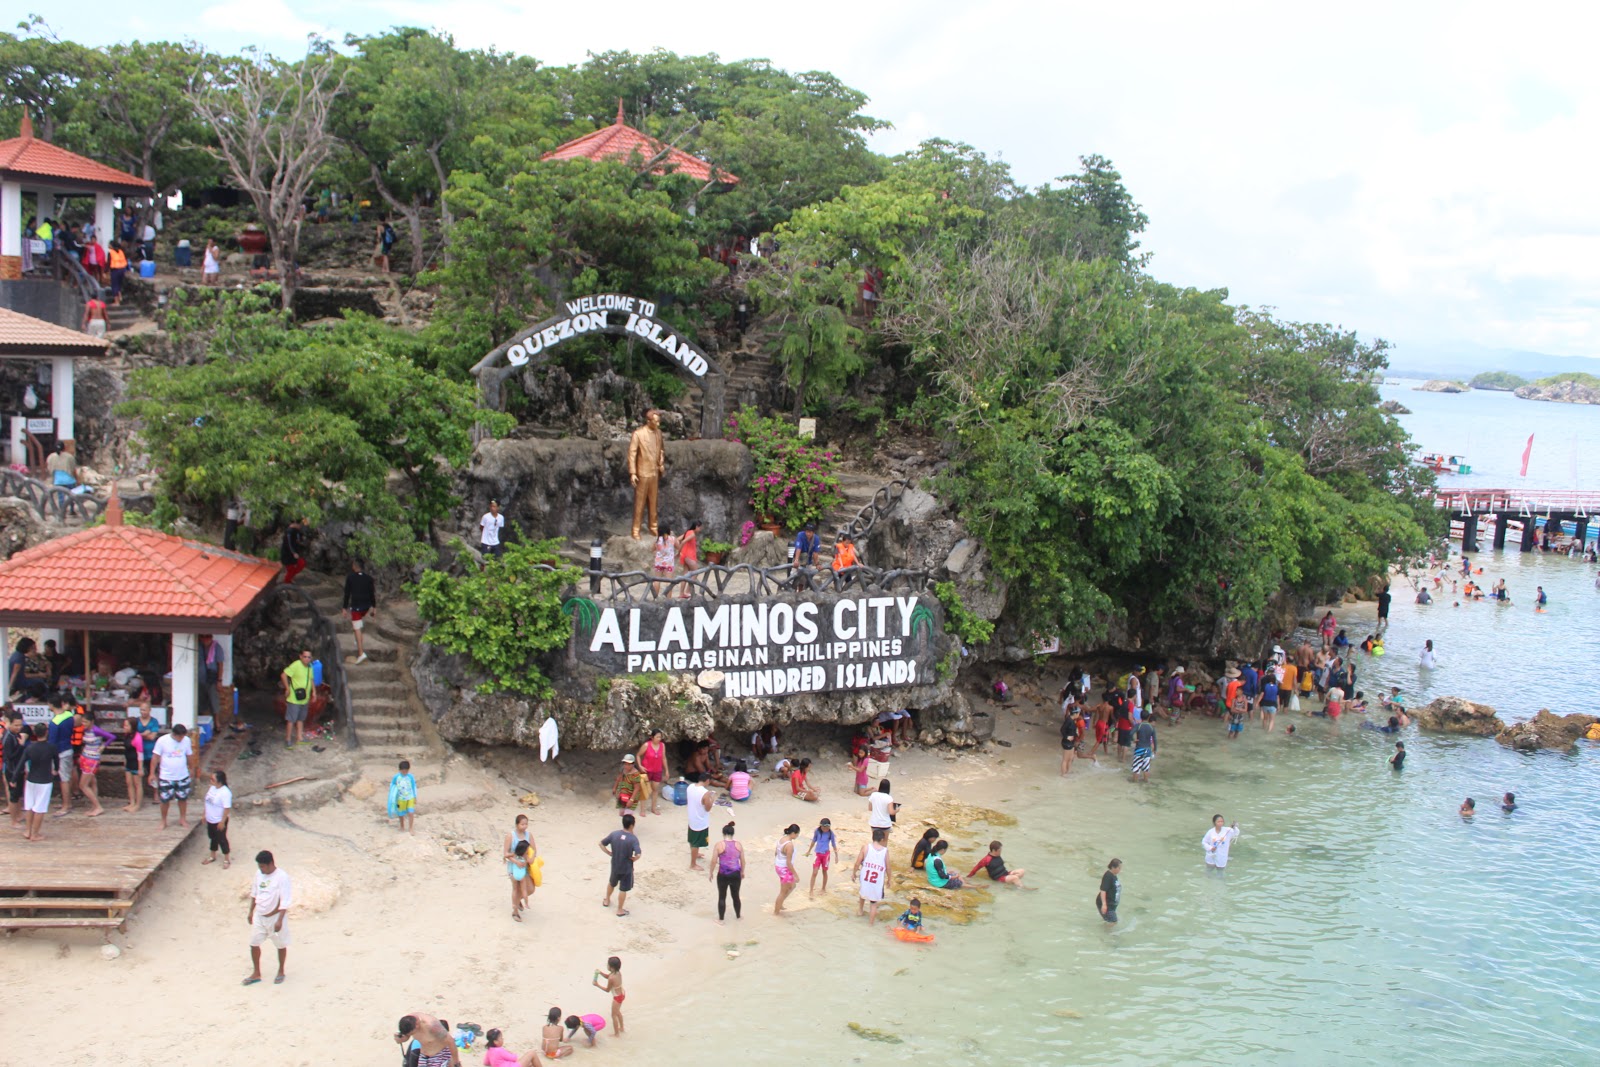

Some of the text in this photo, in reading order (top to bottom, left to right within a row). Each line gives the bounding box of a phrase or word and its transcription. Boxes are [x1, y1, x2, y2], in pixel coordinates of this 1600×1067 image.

[566, 295, 656, 317] WELCOME TO
[506, 311, 709, 377] QUEZON ISLAND
[589, 596, 918, 652] ALAMINOS CITY
[627, 639, 903, 673] PANGASINAN PHILIPPINES
[724, 659, 917, 698] HUNDRED ISLANDS
[864, 869, 879, 884] 12
